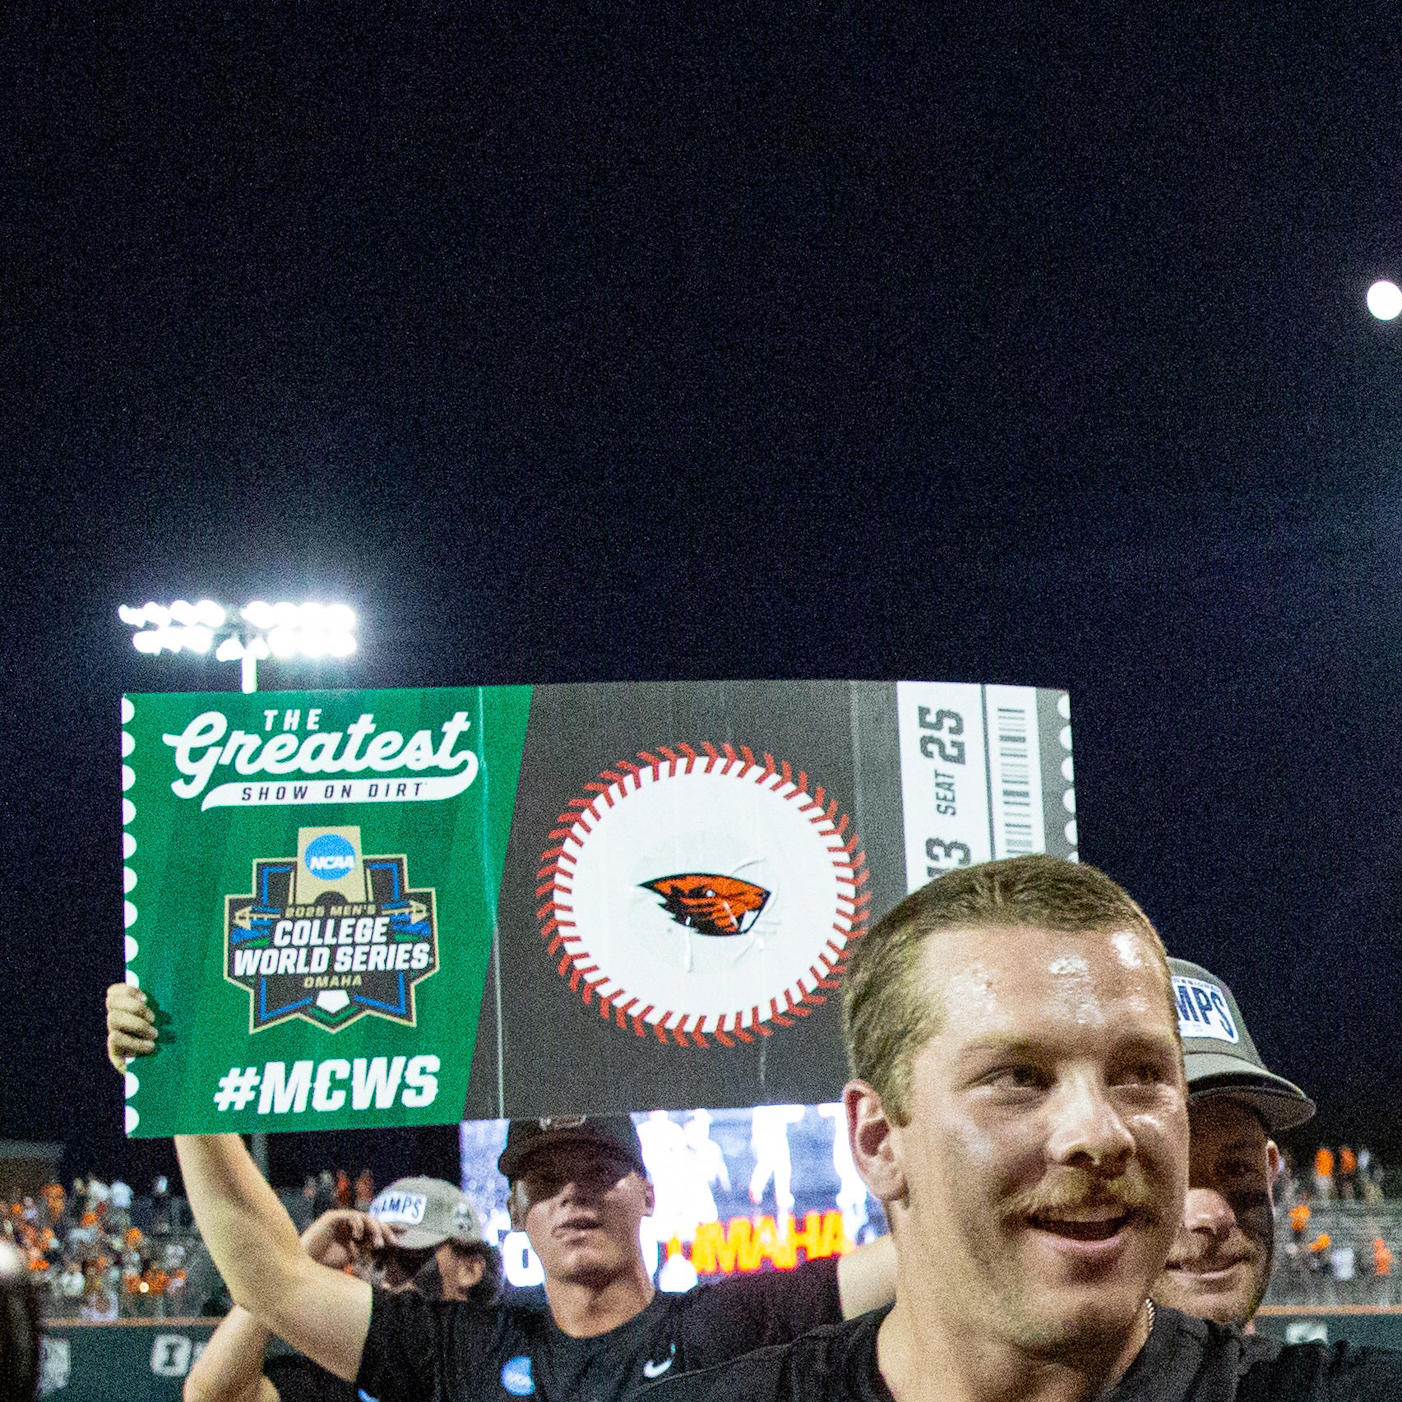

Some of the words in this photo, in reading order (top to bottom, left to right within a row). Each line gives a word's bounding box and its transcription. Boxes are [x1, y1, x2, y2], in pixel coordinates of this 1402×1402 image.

[264, 708, 323, 732] THE
[918, 705, 967, 766] 25
[162, 711, 474, 799] Greatest
[242, 786, 309, 801] SHOW
[324, 784, 353, 799] ON
[368, 781, 425, 798] DIRT
[934, 769, 957, 816] SEAT
[310, 855, 355, 871] NCAA
[273, 916, 390, 947] COLLEGE
[234, 947, 330, 976] WORLD
[333, 943, 431, 973] SERIES
[303, 975, 363, 989] OMAHA
[1177, 986, 1235, 1039] MPS
[213, 1054, 441, 1114] #MCWS
